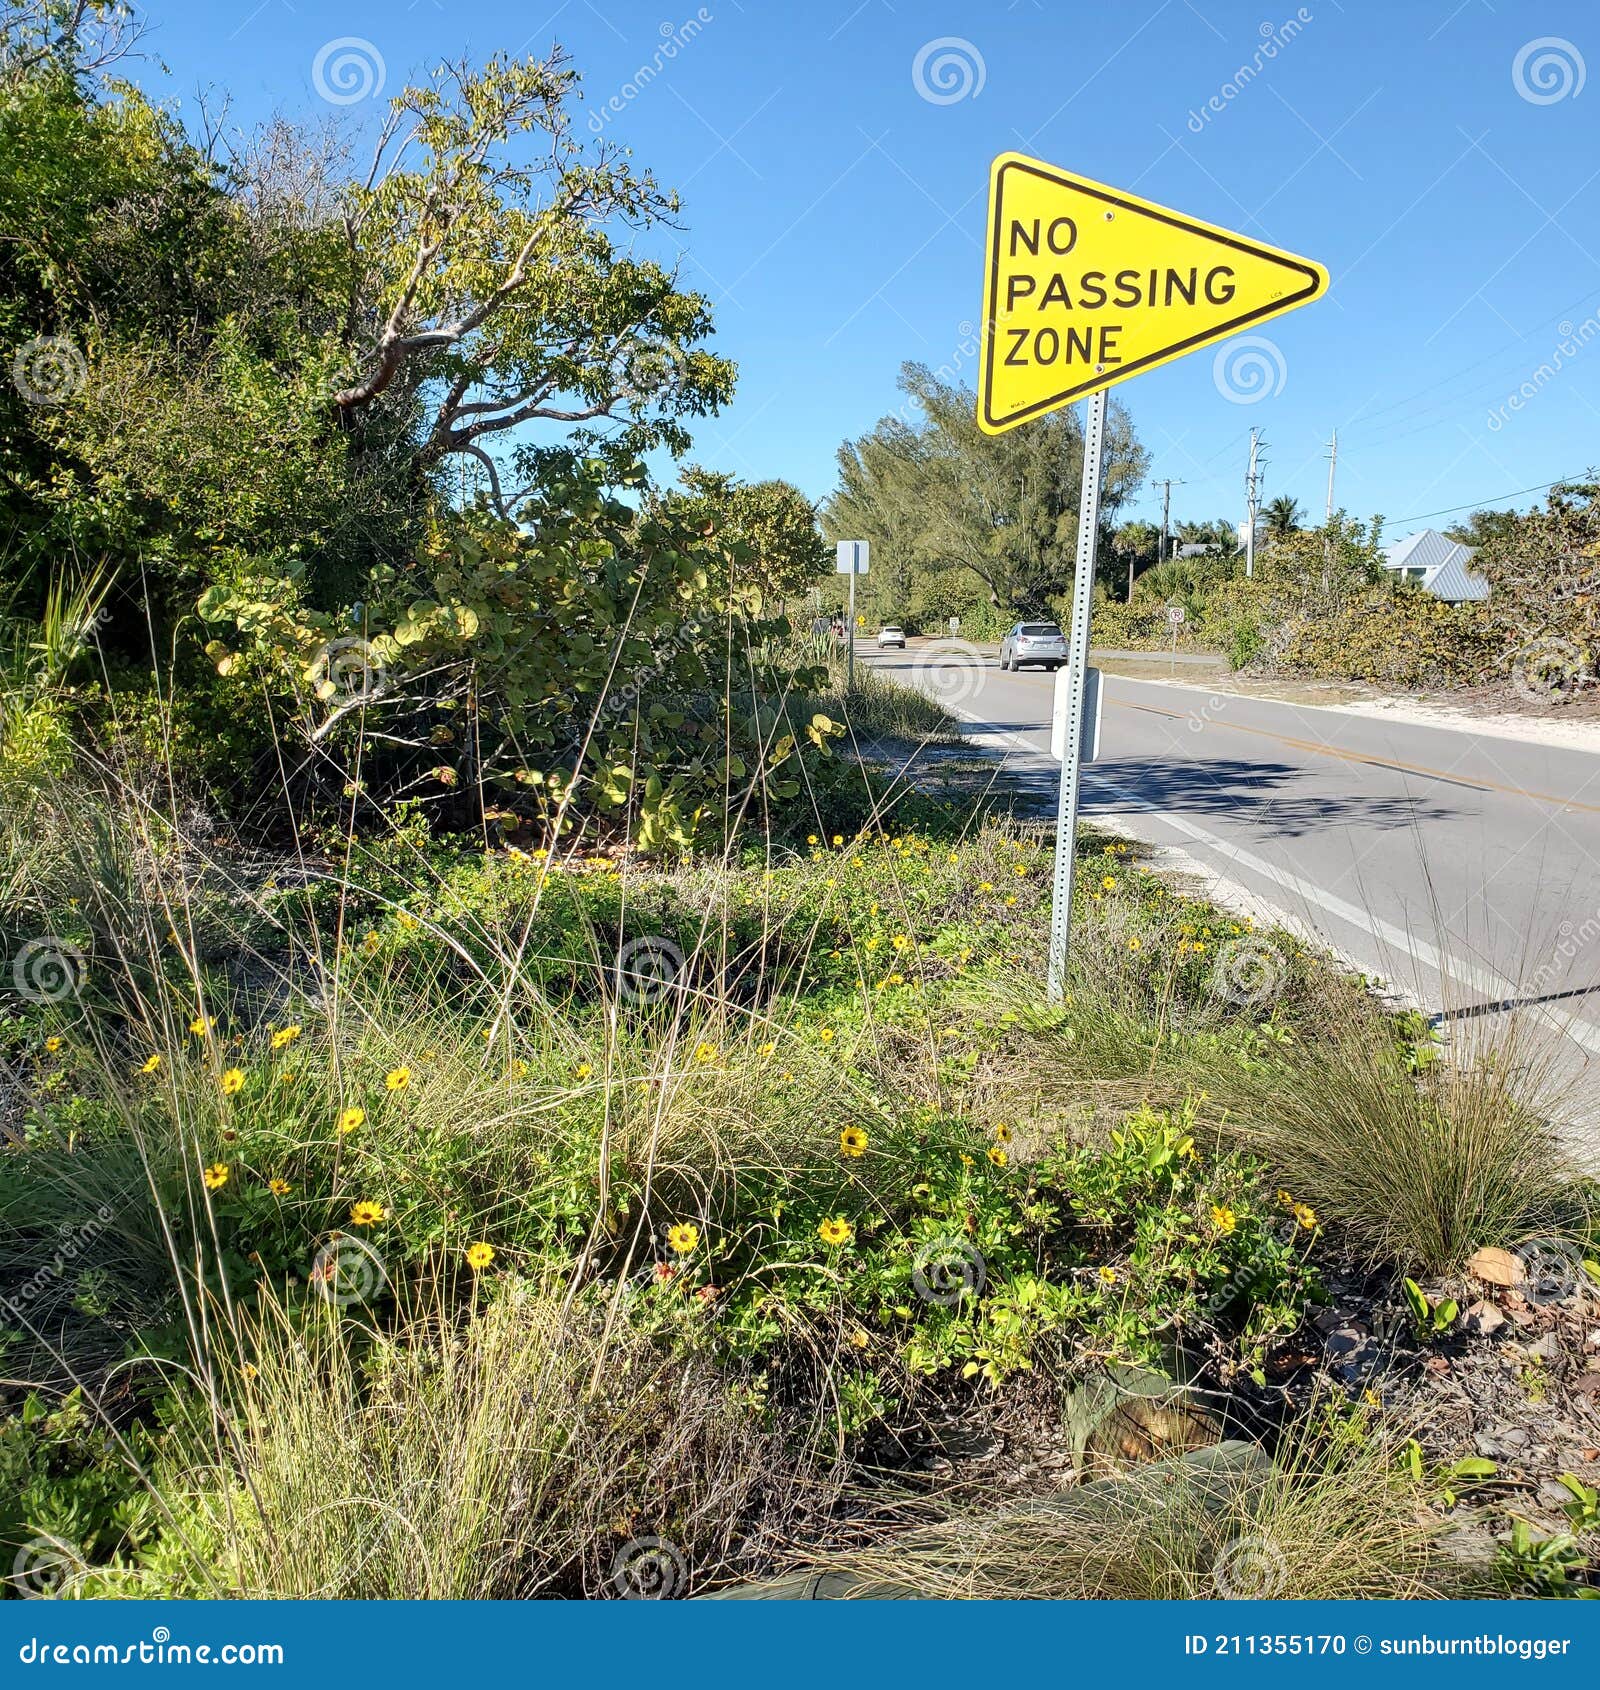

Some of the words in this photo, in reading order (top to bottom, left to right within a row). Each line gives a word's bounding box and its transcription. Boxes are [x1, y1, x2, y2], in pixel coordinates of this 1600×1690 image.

[1009, 217, 1077, 256] NO
[1006, 266, 1236, 312] PASSING
[1004, 326, 1122, 366] ZONE
